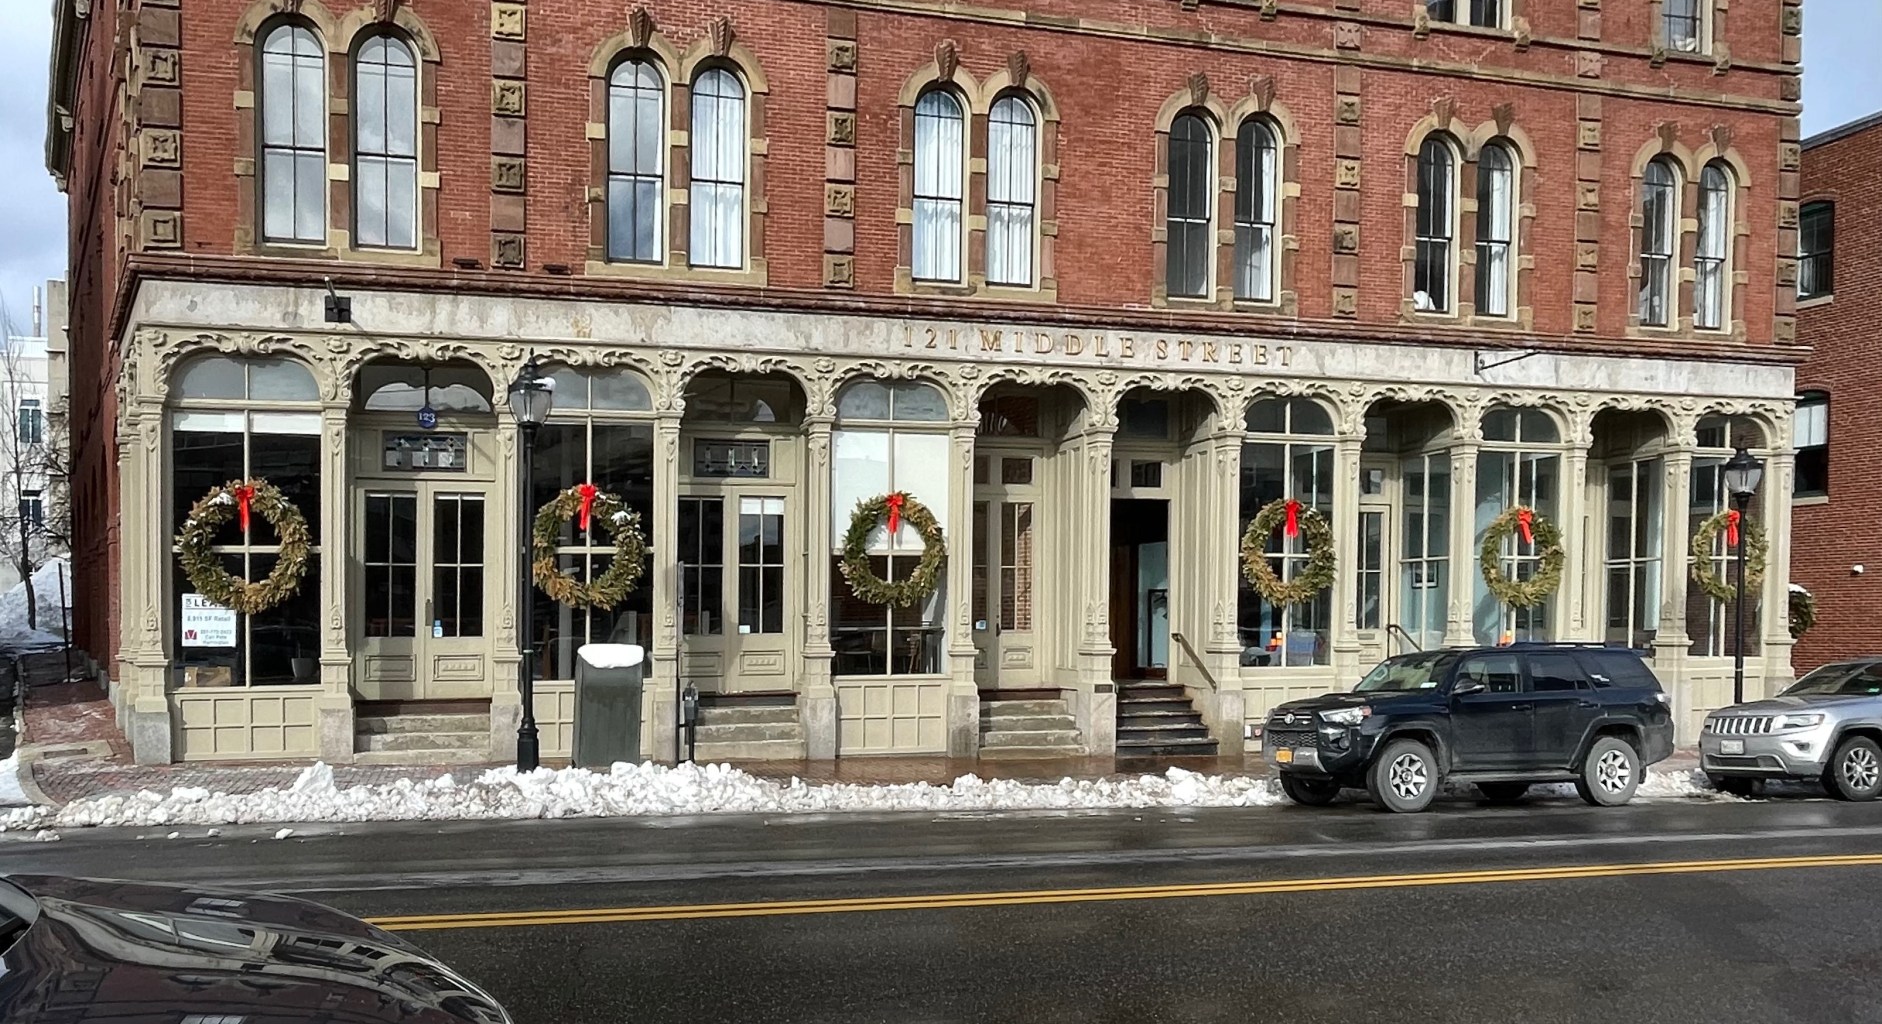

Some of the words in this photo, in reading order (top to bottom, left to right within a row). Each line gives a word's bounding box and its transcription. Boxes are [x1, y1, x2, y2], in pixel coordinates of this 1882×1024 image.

[904, 326, 957, 350] 121
[980, 329, 1135, 358] MIDDLE
[1156, 339, 1292, 366] STREET
[419, 412, 436, 423] 123
